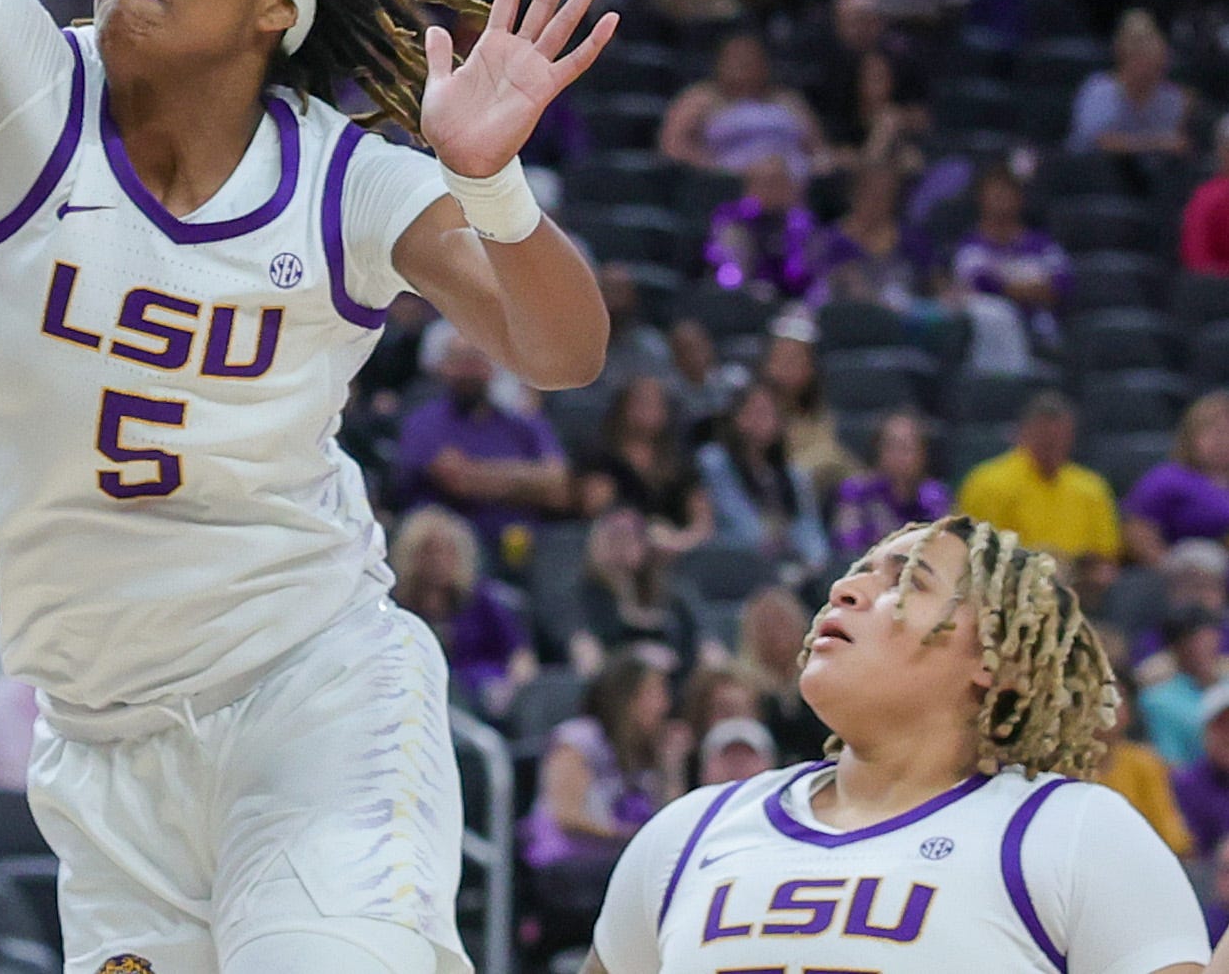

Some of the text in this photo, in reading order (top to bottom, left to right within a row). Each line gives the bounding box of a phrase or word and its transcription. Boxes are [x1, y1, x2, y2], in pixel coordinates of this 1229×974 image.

[270, 253, 303, 289] SEC
[40, 259, 286, 381] LSU
[94, 386, 189, 500] 5
[700, 876, 939, 946] LSU
